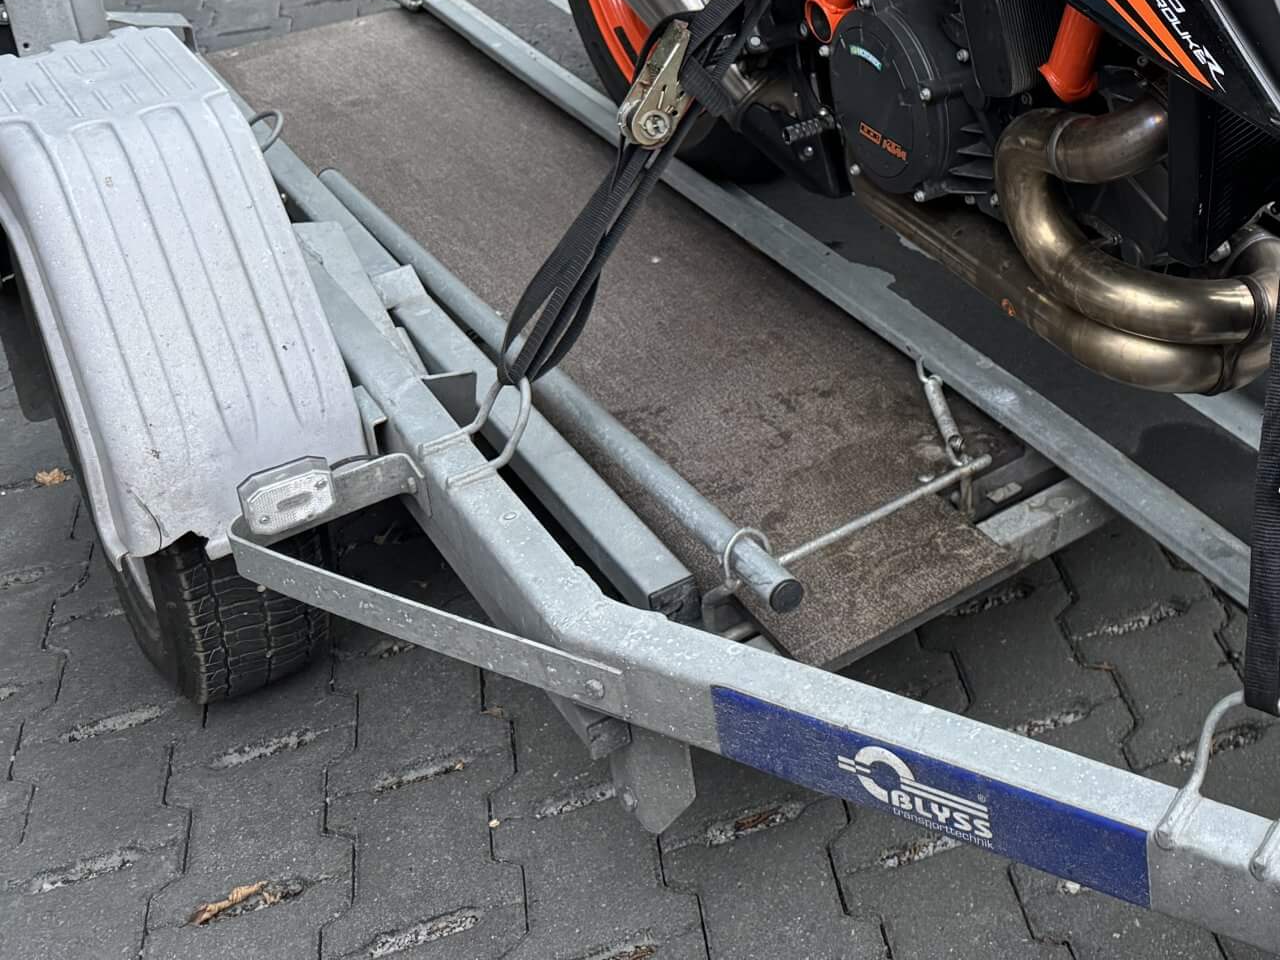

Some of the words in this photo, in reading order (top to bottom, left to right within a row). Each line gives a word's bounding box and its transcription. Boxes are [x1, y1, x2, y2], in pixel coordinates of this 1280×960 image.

[1202, 45, 1226, 92] R
[890, 790, 993, 839] BLYSS
[892, 807, 994, 850] transporttechnik
